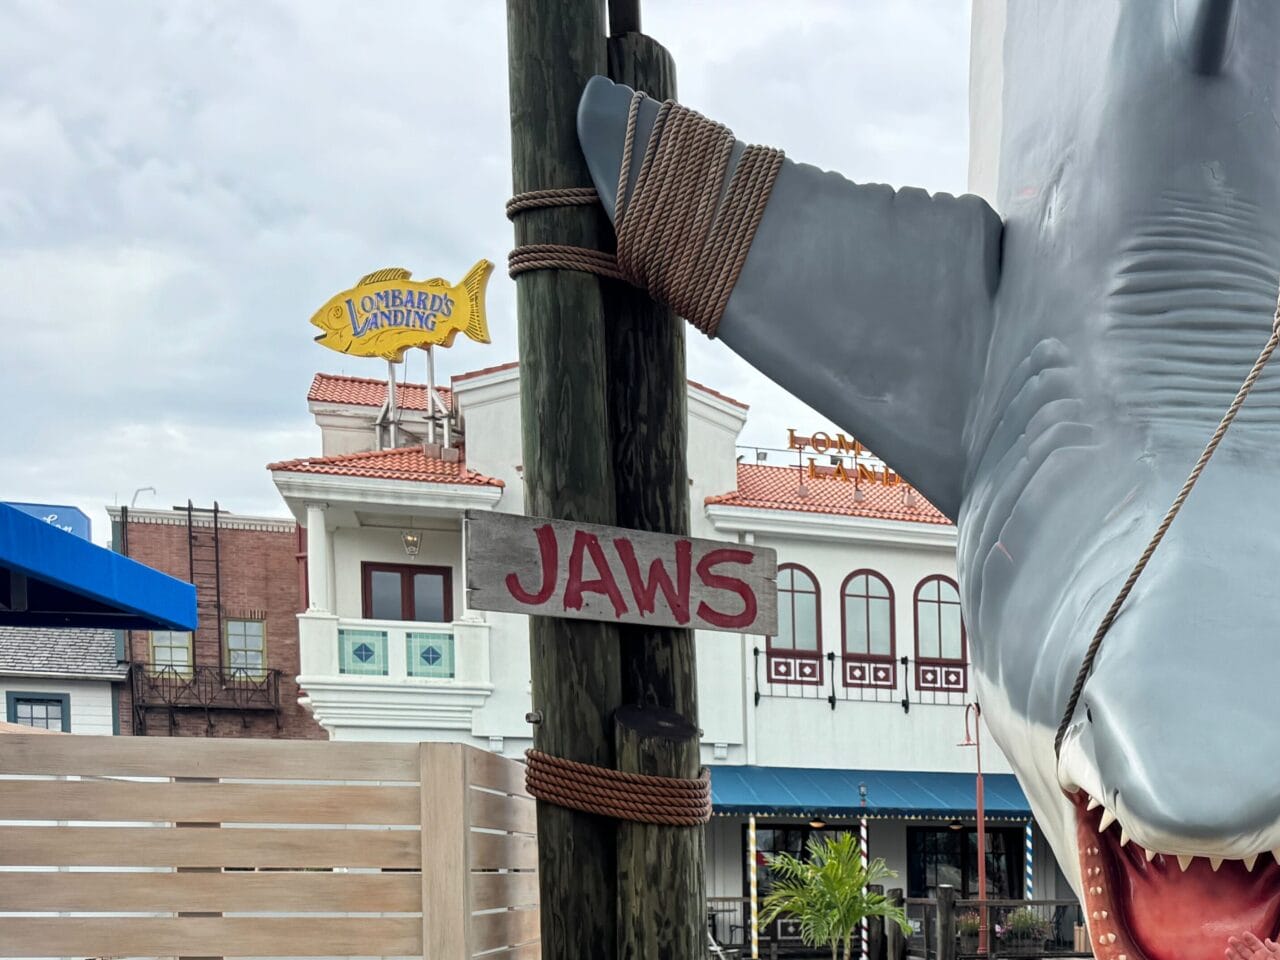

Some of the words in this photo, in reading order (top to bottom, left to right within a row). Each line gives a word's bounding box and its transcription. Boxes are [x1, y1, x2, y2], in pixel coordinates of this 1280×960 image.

[345, 289, 455, 335] LOMBARD'S
[787, 428, 868, 456] LOM
[505, 524, 758, 629] JAWS
